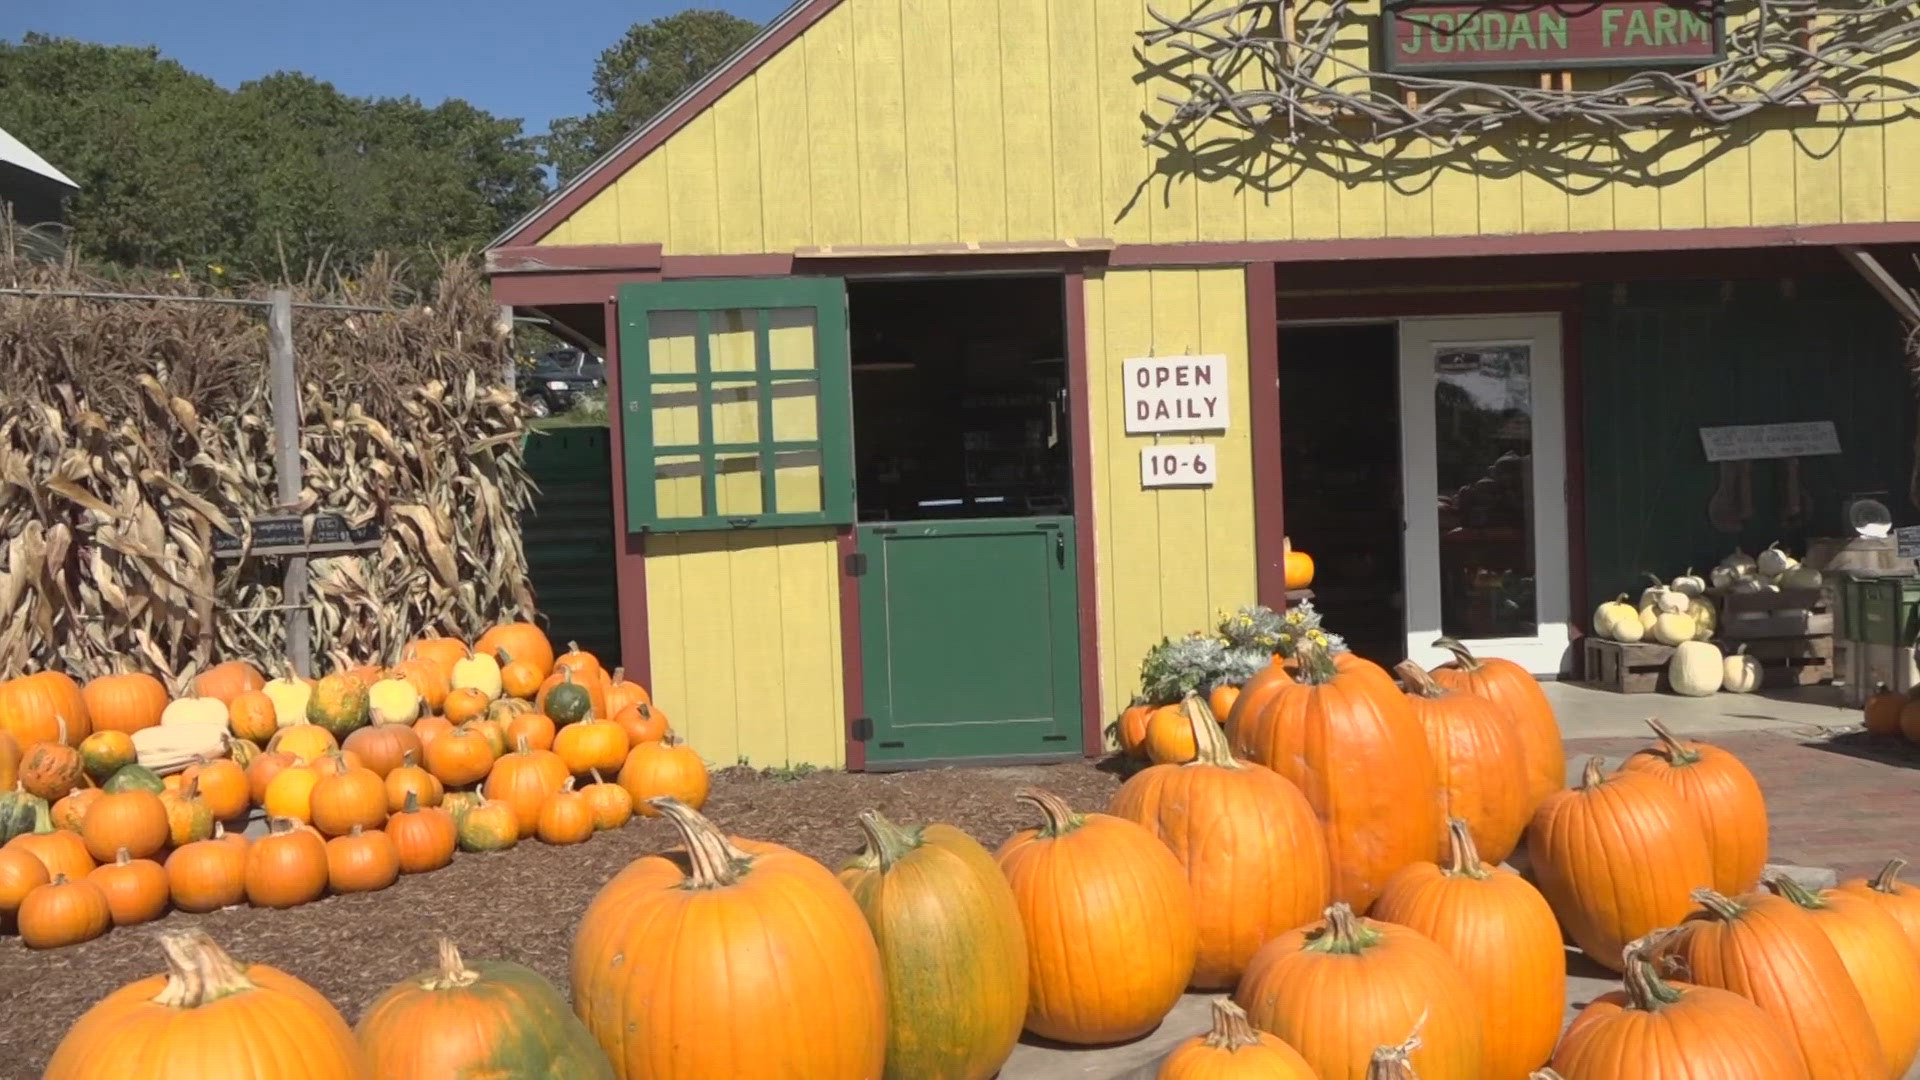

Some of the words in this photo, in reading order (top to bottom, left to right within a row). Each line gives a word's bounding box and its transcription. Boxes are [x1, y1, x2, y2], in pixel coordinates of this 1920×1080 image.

[1401, 13, 1568, 53] JORDAN
[1601, 8, 1710, 48] FARM
[1136, 365, 1211, 388] OPEN
[1136, 397, 1217, 420] DAILY
[1151, 454, 1207, 476] 10-6
